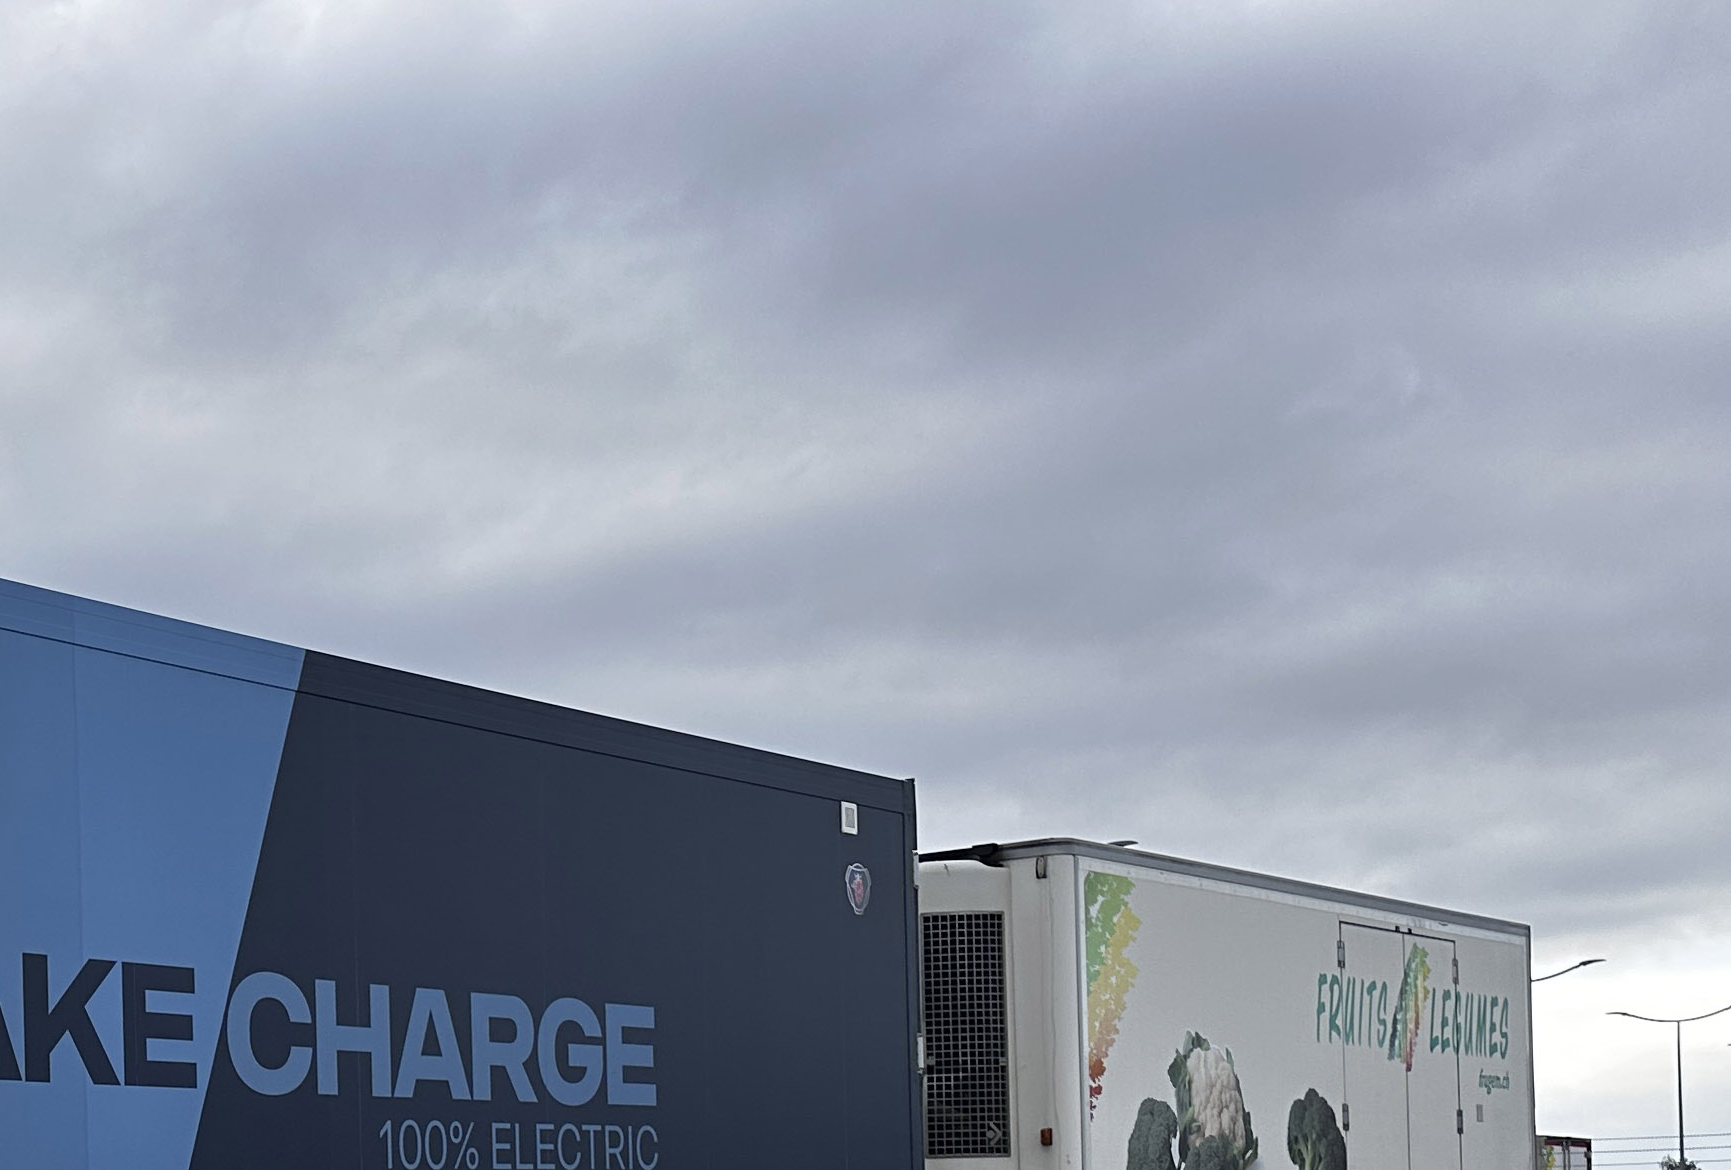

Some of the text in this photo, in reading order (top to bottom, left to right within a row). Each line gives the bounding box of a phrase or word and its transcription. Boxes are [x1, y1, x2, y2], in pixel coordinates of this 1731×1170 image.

[226, 970, 659, 1107] CHARGE
[1316, 973, 1509, 1060] FRUITS LEGUMES
